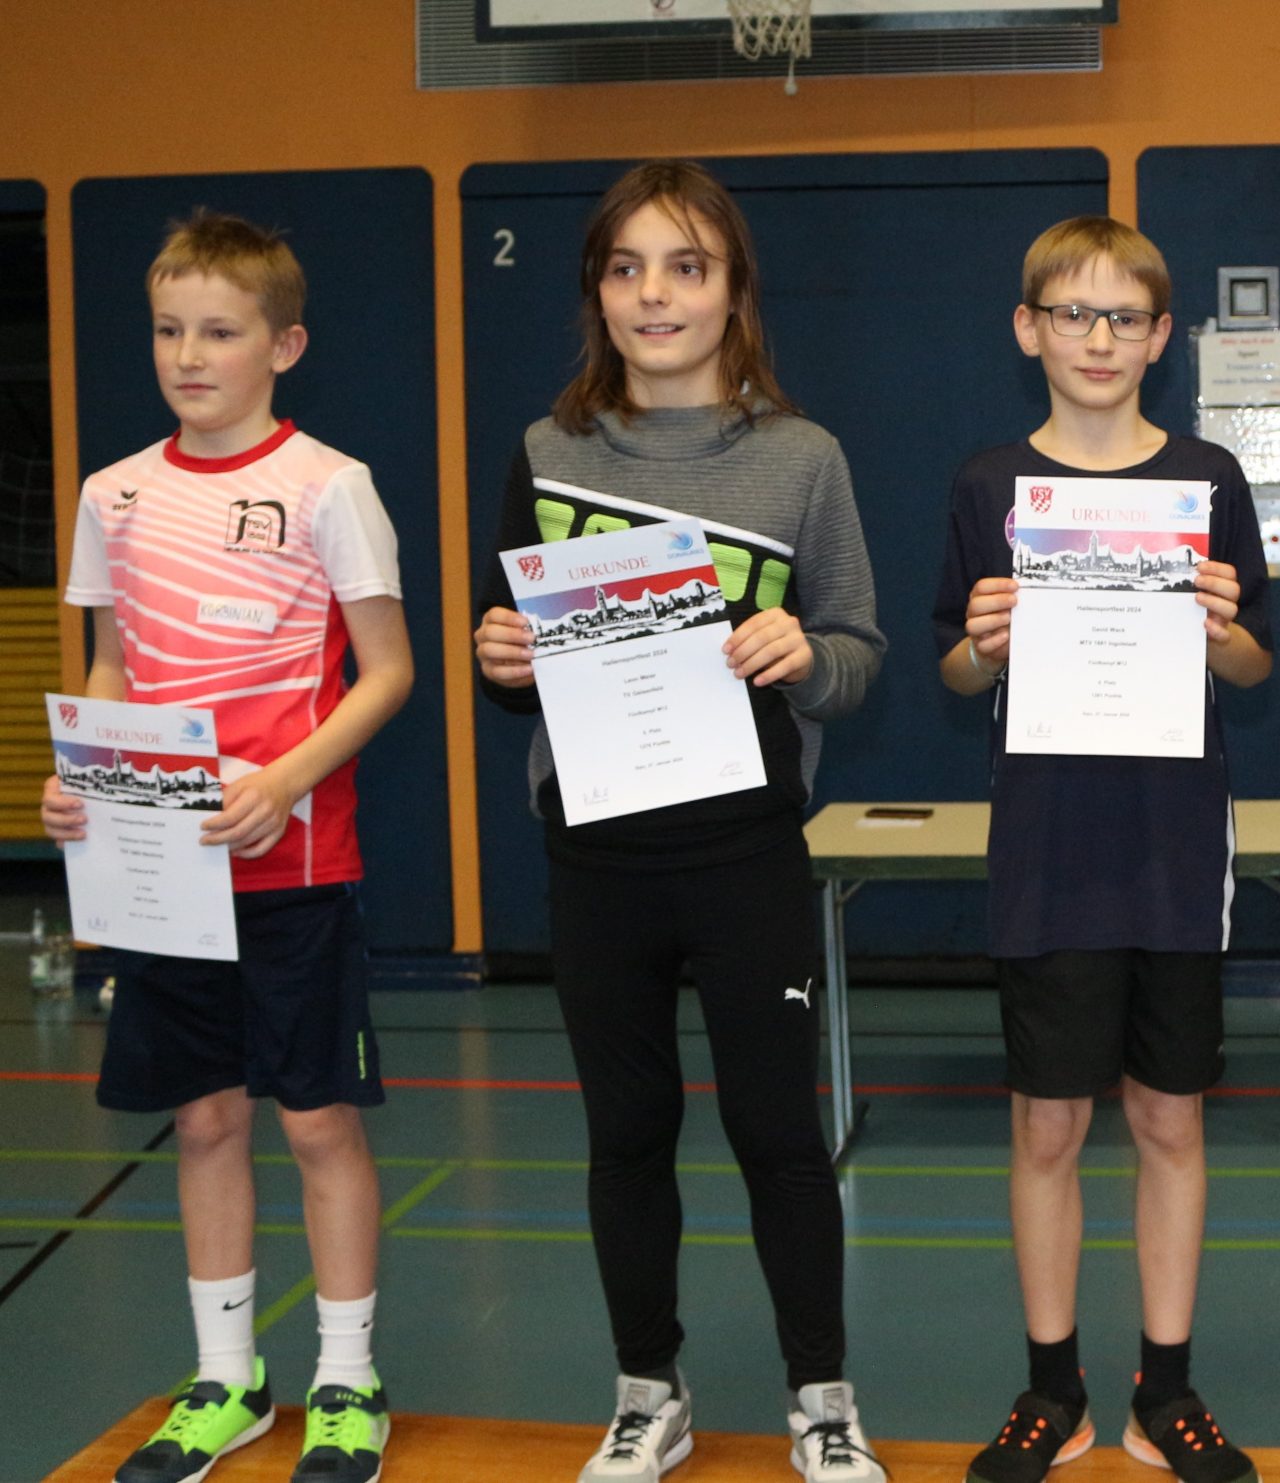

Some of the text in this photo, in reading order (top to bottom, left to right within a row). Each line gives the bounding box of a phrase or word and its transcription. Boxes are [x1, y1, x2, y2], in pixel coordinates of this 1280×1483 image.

[493, 229, 515, 266] 2
[1031, 486, 1051, 500] TSV
[520, 557, 539, 570] TSV
[568, 556, 650, 581] URKUNDE
